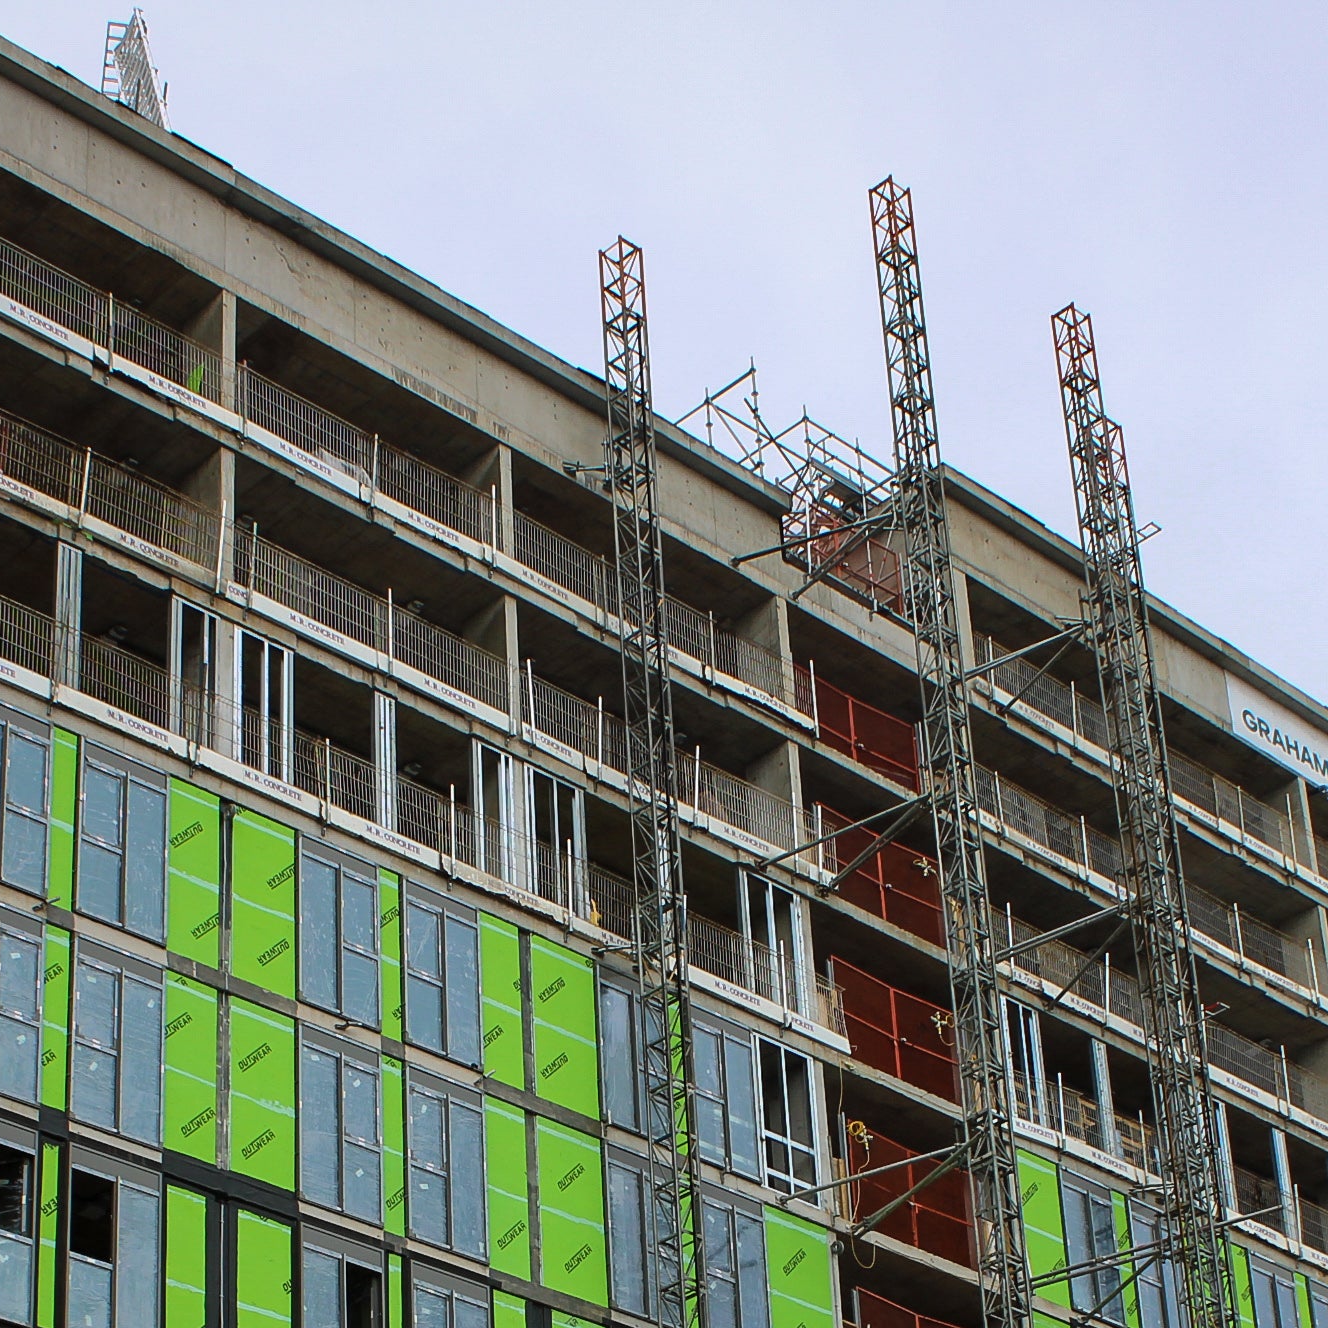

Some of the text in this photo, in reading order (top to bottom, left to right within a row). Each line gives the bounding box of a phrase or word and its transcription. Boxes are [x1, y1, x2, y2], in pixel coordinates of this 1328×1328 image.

[139, 540, 179, 566] CONCRETE
[128, 716, 168, 741] CONCRETE
[263, 778, 302, 801] CONCRETE
[257, 940, 290, 965] OUTWEAR
[538, 979, 566, 1002] OUTWEAR
[238, 1045, 272, 1070] OUTWEAR
[541, 1055, 569, 1078] OUTWEAR
[181, 1109, 215, 1136] OUTWEAR
[241, 1131, 276, 1157] OUTWEAR
[557, 1165, 585, 1190] OUTWEAR
[497, 1222, 527, 1248] OUTWEAR
[564, 1246, 592, 1272] OUTWEAR
[782, 1250, 807, 1275] OUTWEAR
